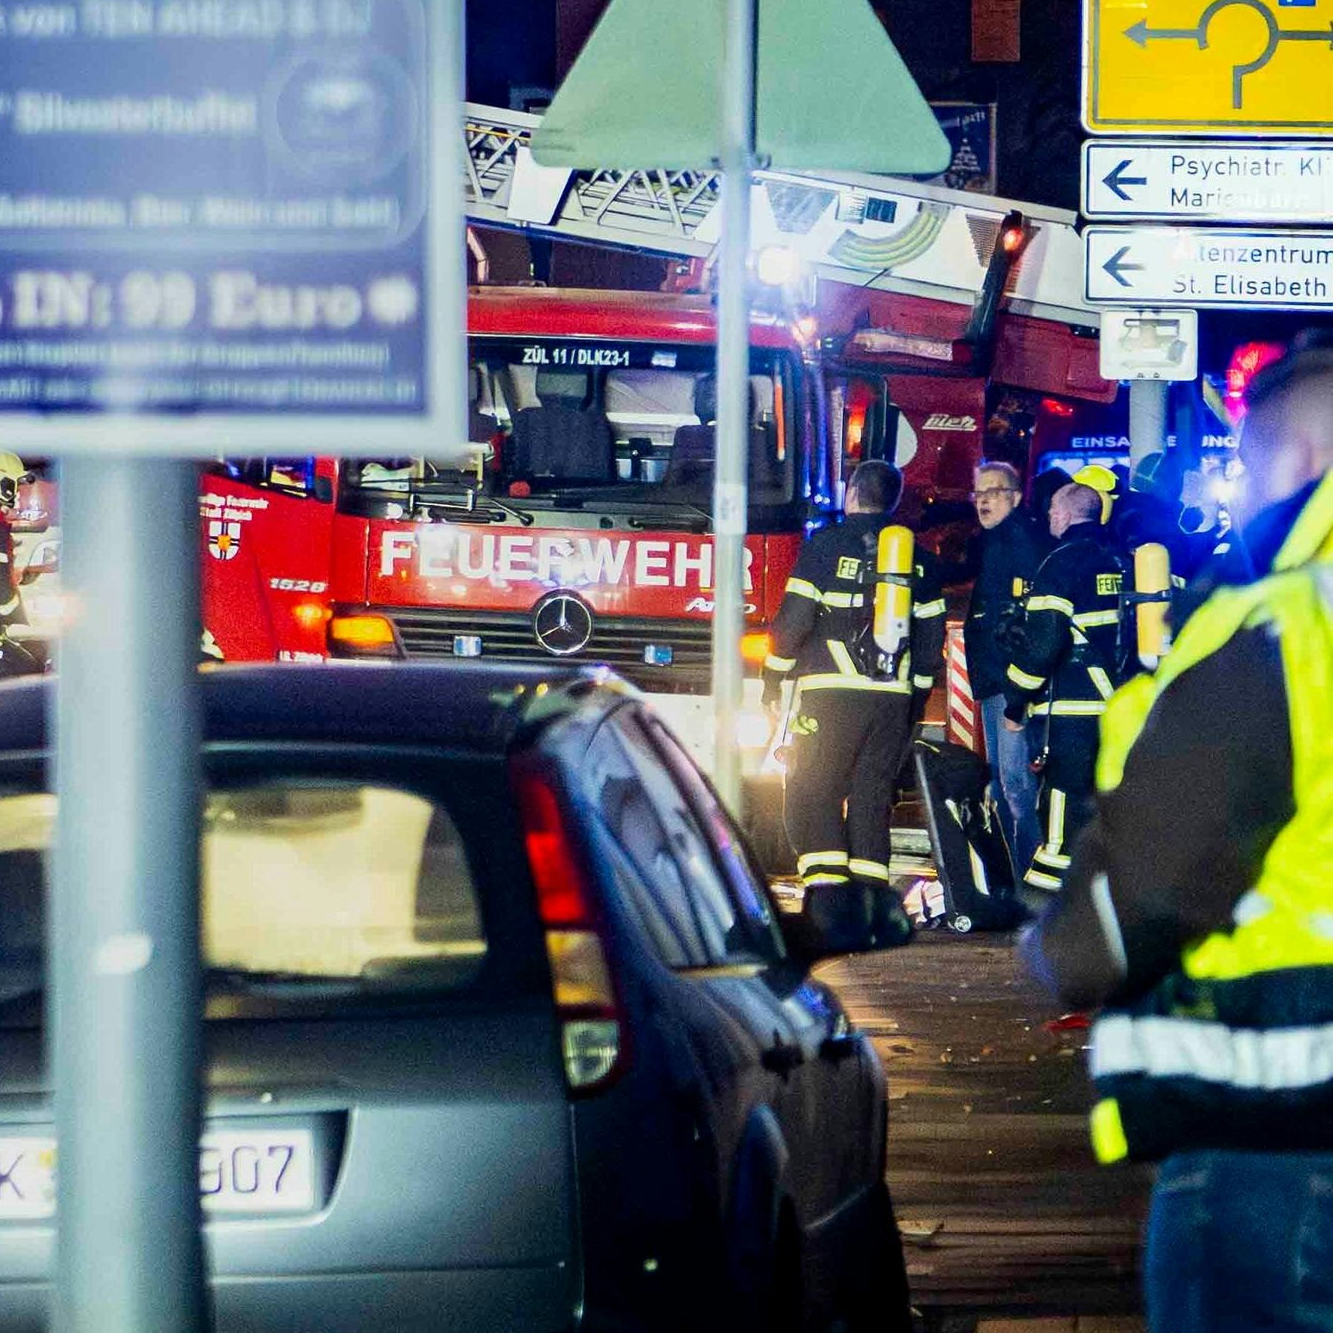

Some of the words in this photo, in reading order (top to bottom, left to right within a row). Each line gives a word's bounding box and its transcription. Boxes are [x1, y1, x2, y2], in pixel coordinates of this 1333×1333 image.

[1300, 156, 1333, 176] Kl
[1172, 274, 1202, 295] St.
[1214, 274, 1327, 297] Elisabeth
[13, 271, 110, 328] IN:
[210, 271, 363, 328] Euro
[522, 345, 549, 365] ZÜL
[552, 348, 568, 365] 11
[578, 349, 630, 366] DLK23-1
